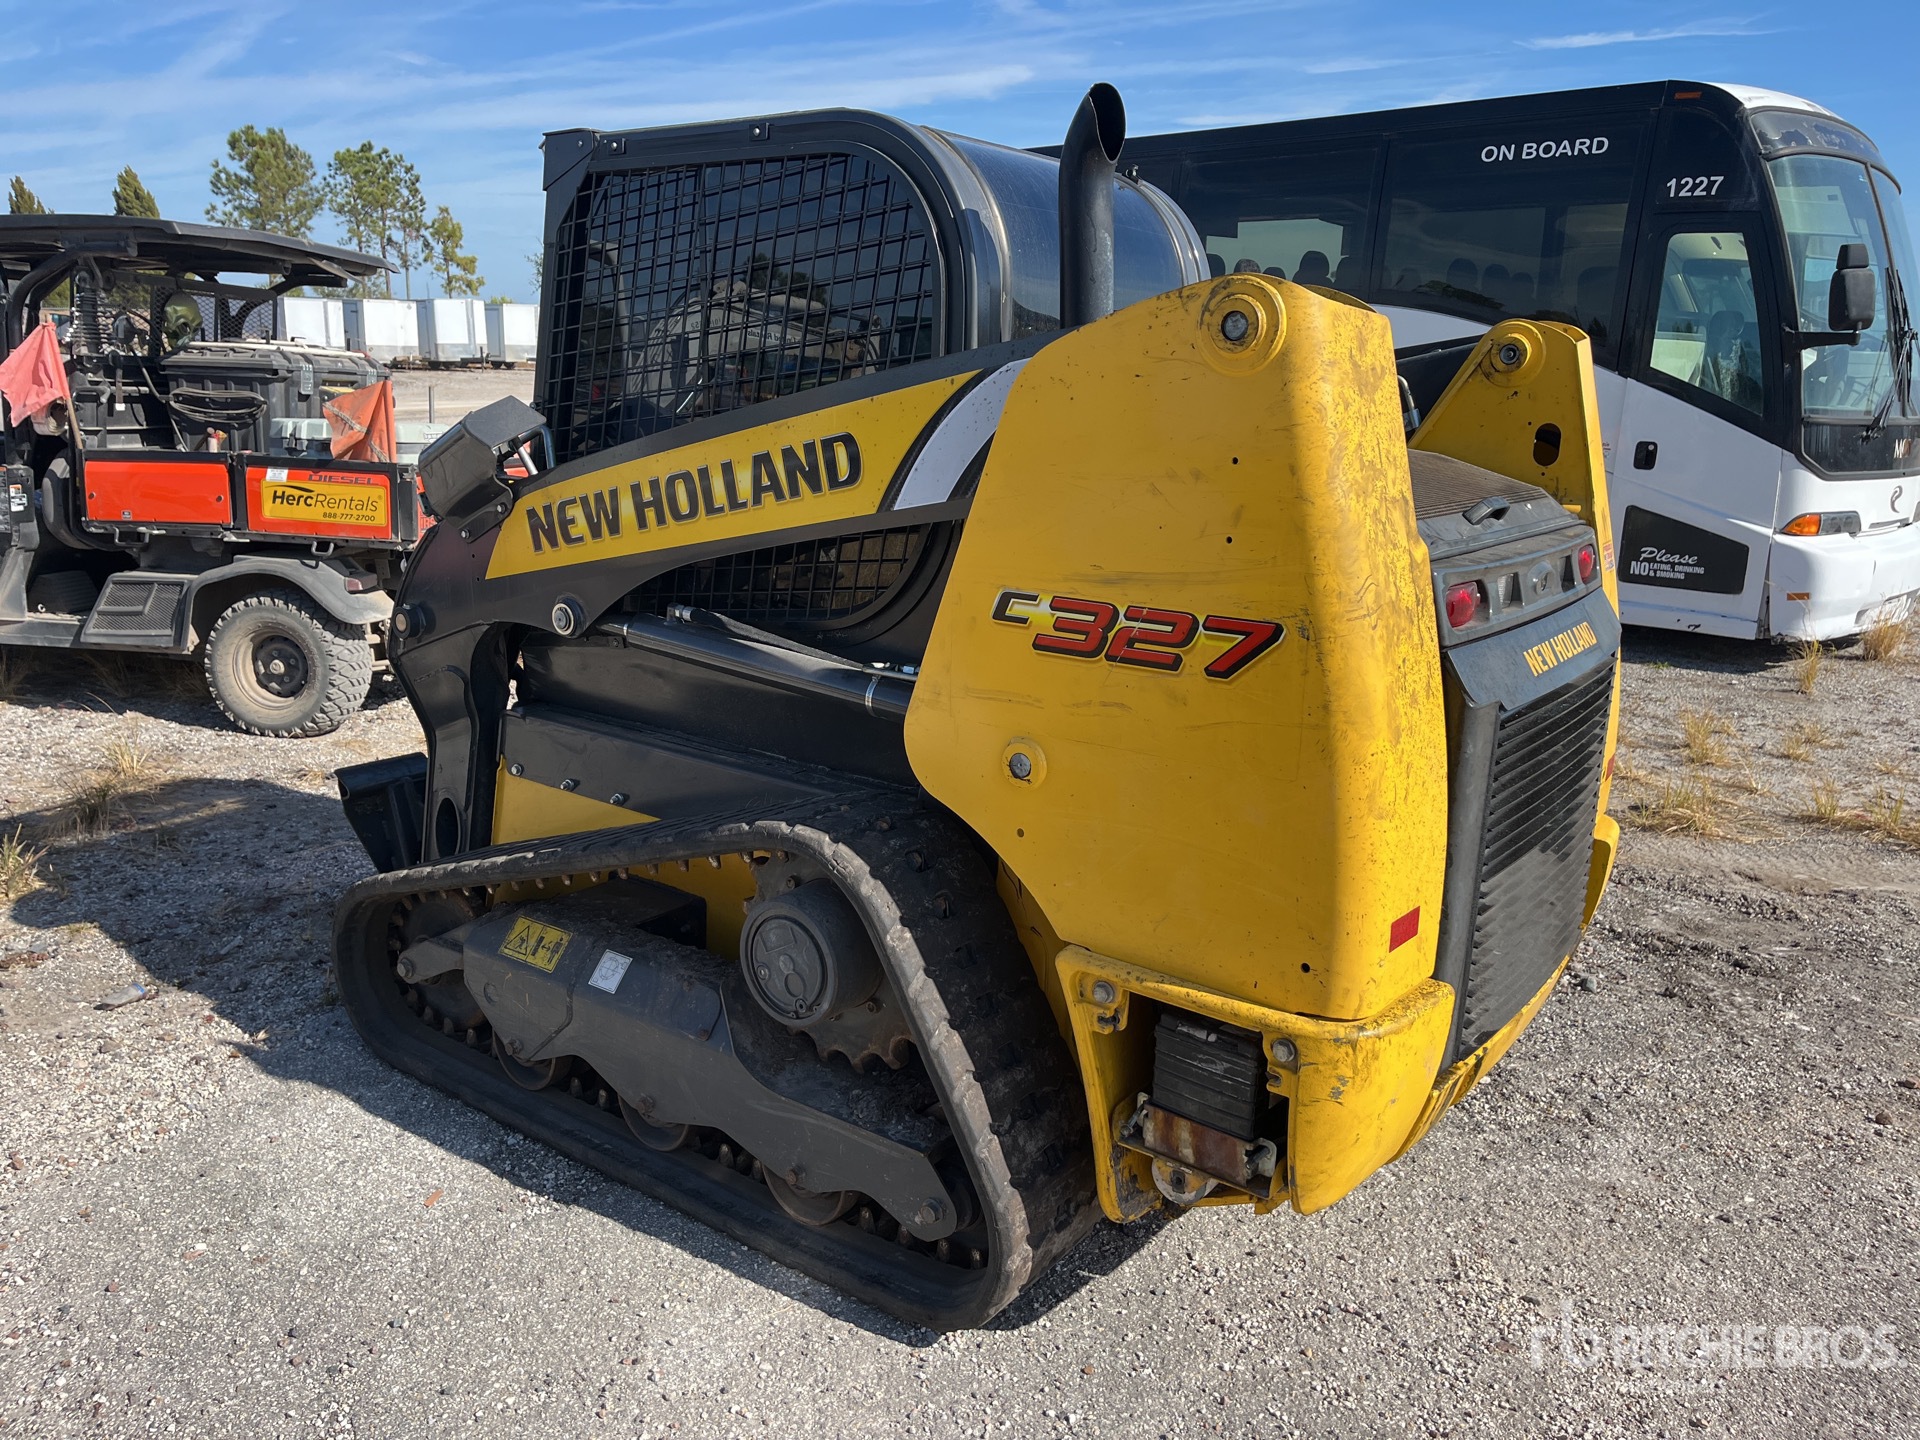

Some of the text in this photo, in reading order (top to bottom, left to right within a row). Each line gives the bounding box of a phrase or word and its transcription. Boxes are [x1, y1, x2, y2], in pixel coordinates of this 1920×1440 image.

[1481, 137, 1609, 163] ON BOARD
[1666, 176, 1724, 198] 1227
[309, 474, 379, 486] DIESEL
[525, 431, 863, 553] NEW HOLLAND
[323, 512, 376, 522] 888-777-2700
[1640, 547, 1698, 564] Please
[1630, 561, 1705, 576] NO EATING, DRINKING
[1656, 571, 1685, 579] SMOKING
[1523, 621, 1598, 677] NEW HOLLAND
